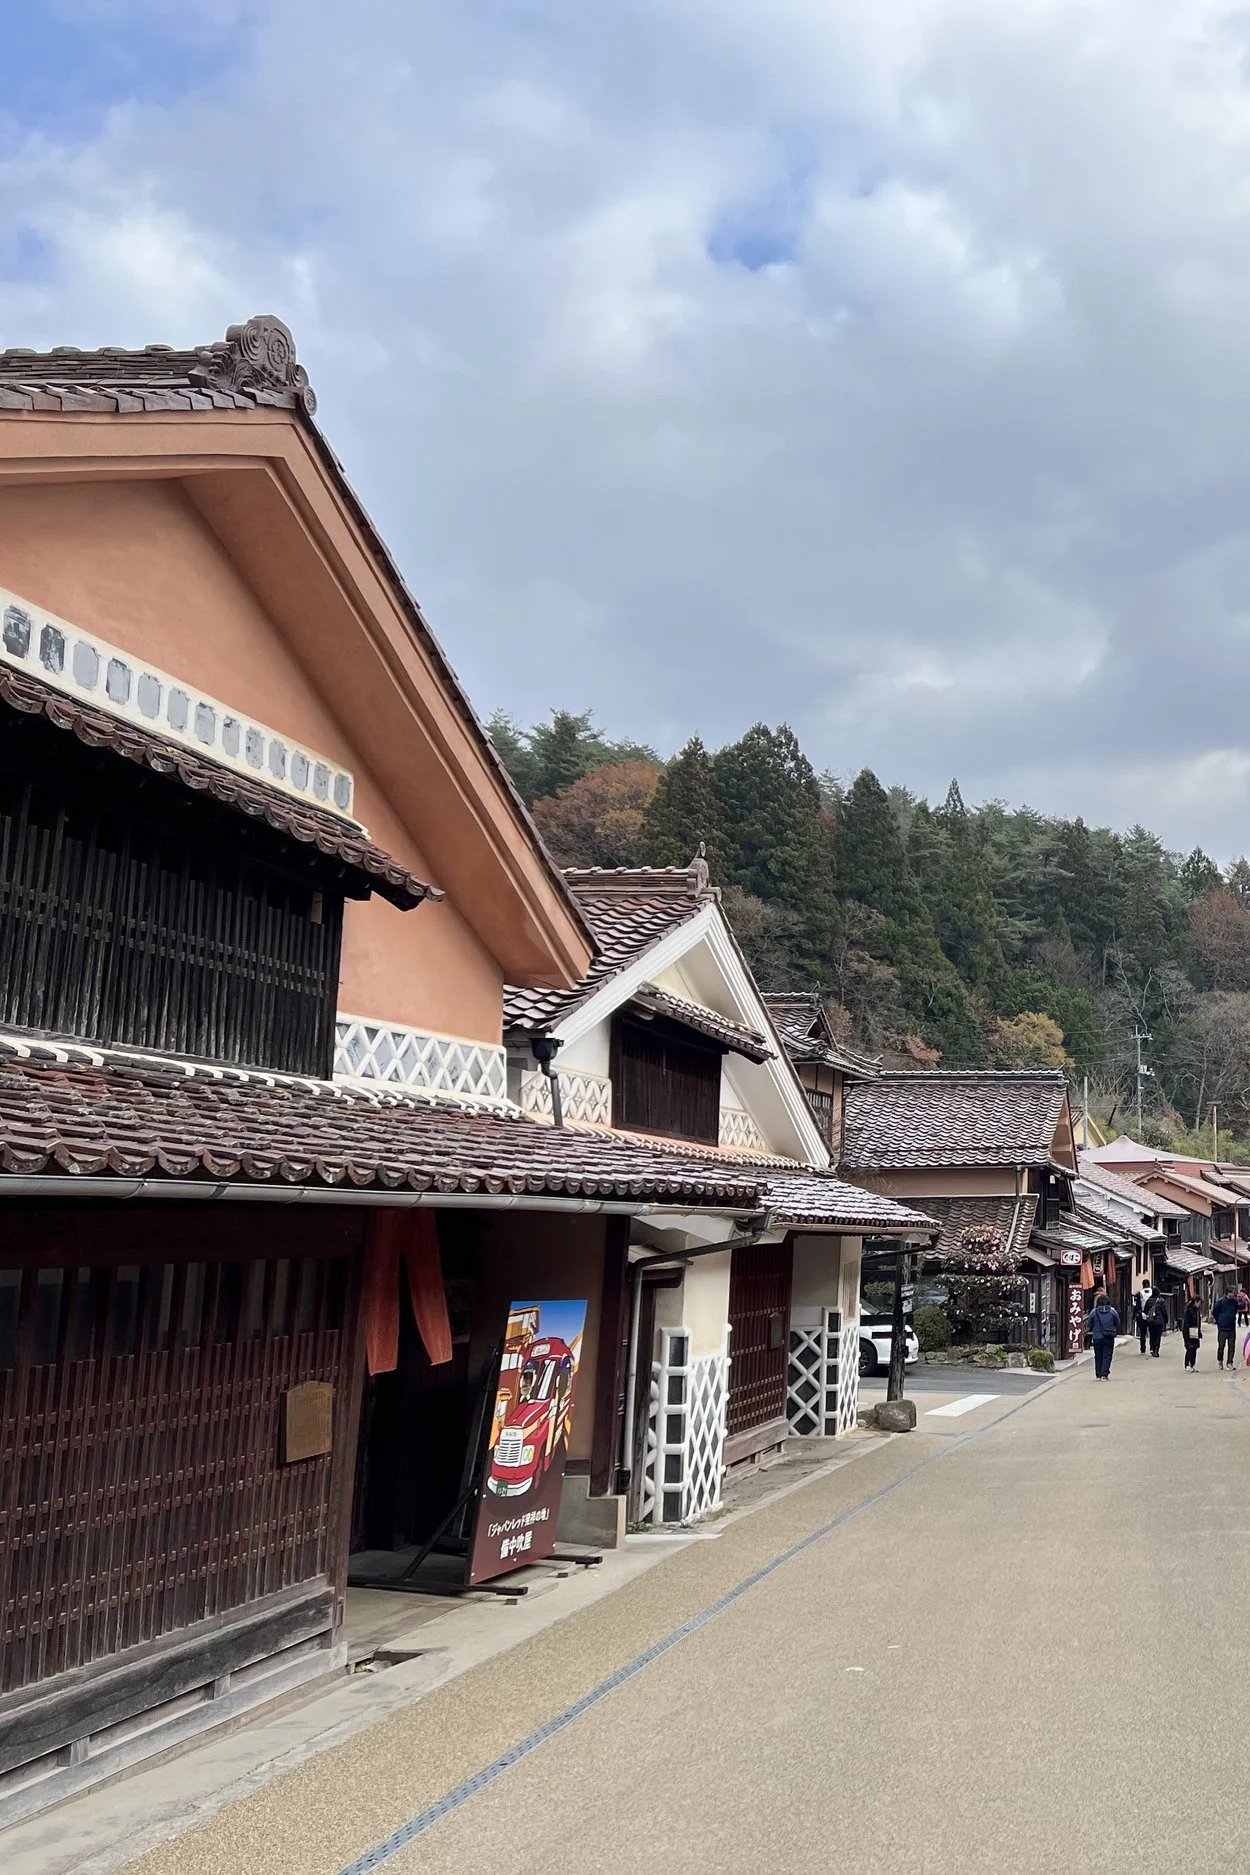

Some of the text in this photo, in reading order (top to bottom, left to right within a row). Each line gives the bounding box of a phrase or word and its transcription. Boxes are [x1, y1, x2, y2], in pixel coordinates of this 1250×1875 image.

[1069, 1289, 1082, 1342] おみやげ
[500, 1531, 533, 1559] 備中吹屋
